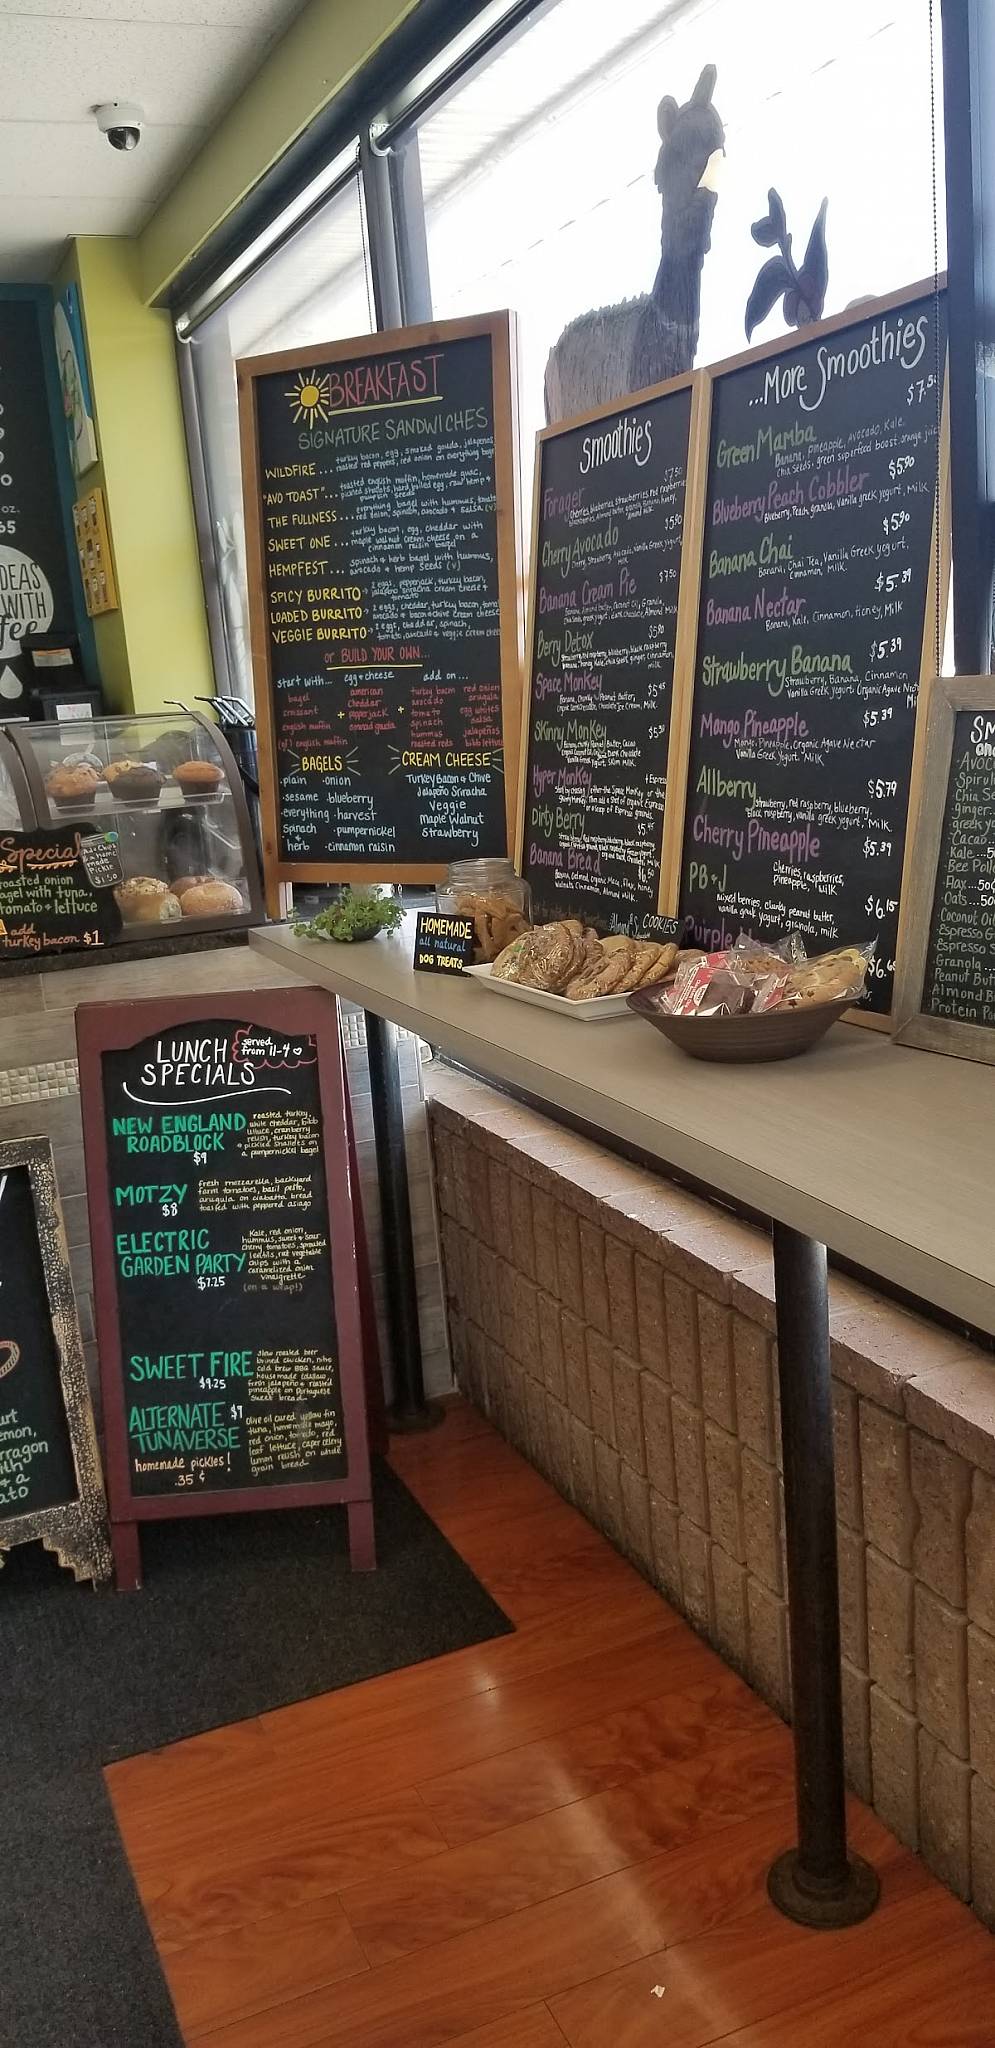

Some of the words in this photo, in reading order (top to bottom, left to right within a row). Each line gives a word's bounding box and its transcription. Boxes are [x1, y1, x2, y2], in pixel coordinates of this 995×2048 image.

[799, 316, 929, 411] Smoothies
[329, 354, 445, 408] BREAKFAST
[298, 423, 380, 450] SIGNATURE
[385, 407, 488, 440] SANDWICHES
[579, 417, 652, 474] Smoothies
[717, 440, 756, 468] Green
[757, 421, 816, 457] Mamba
[543, 487, 585, 521] Forager
[712, 495, 765, 527] Blueberry
[768, 479, 803, 511] Peach
[809, 466, 870, 501] Cobbler
[268, 515, 288, 527] THE
[268, 537, 305, 552] SWEET
[309, 536, 331, 549] ONE
[542, 540, 570, 578] Cherry
[573, 520, 619, 555] Avocado
[709, 549, 757, 579] Banana
[758, 535, 793, 563] Chai
[271, 590, 302, 604] SPICY
[307, 586, 361, 601] BURRITO
[539, 586, 576, 615] Banana
[582, 580, 613, 604] Cream
[619, 567, 637, 596] Pie
[271, 610, 308, 624] LOADED
[313, 606, 362, 621] BURRITO
[706, 598, 751, 626] Banana
[755, 588, 806, 617] Nectar
[272, 629, 313, 645] VEGGIE
[316, 626, 367, 640] BURRITO
[324, 652, 333, 663] or
[341, 648, 367, 663] BUILD
[373, 647, 394, 661] YOUR
[537, 630, 560, 668] Berry
[564, 631, 593, 650] Detox
[423, 671, 441, 681] add
[702, 652, 787, 697] Strawberry
[791, 645, 853, 674] Banana
[277, 676, 302, 689] start
[536, 673, 562, 700] Space
[700, 713, 740, 749] Mango
[743, 709, 809, 745] Pineapple
[843, 739, 876, 749] Nectar
[302, 755, 343, 772] BAGELS
[402, 752, 441, 767] CREAM
[446, 752, 491, 767] CHEESE
[469, 772, 491, 783] Chive
[533, 765, 556, 798] Hyper
[697, 765, 756, 808] Allberry
[956, 788, 979, 801] Chia
[429, 800, 466, 815] Veggie
[449, 813, 483, 824] Walnut
[532, 808, 553, 838] Dirty
[555, 808, 585, 834] Berry
[287, 839, 310, 851] herb
[368, 842, 395, 852] raisin
[693, 815, 743, 861] Cherry
[748, 820, 820, 864] Pineapple
[1, 832, 81, 873] Special
[529, 844, 563, 866] Banana
[567, 848, 602, 874] Bread
[948, 859, 969, 873] Bee
[45, 876, 73, 885] onion
[689, 862, 707, 892] PB
[719, 864, 726, 891] J
[26, 885, 51, 898] with
[0, 899, 42, 914] tomato
[55, 899, 98, 914] lettuce
[940, 908, 977, 926] Coconut
[11, 924, 36, 936] add
[420, 917, 472, 939] HOMEMADE
[939, 924, 983, 940] Espresso
[43, 933, 79, 945] bacon
[84, 930, 104, 945] $1
[419, 936, 430, 946] all
[435, 938, 466, 951] natural
[937, 939, 986, 954] Espresso
[420, 954, 434, 964] DOG
[437, 955, 463, 969] TREATS
[936, 954, 981, 971] Granola
[935, 968, 970, 982] Peanut
[932, 984, 982, 1001] Almond
[931, 998, 976, 1017] Protein
[241, 1038, 273, 1046] served
[241, 1046, 266, 1056] from
[157, 1039, 228, 1064] LUNCH
[140, 1062, 256, 1086] SPECIALS
[113, 1117, 153, 1135] NEW
[161, 1113, 246, 1134] ENGLAND
[127, 1133, 224, 1153] ROADBLOCK
[193, 1151, 207, 1165] $9
[116, 1183, 187, 1206] MOTZY
[162, 1203, 177, 1217] $8
[117, 1229, 209, 1255] ELECTRIC
[120, 1253, 190, 1278] GARDEN
[196, 1253, 245, 1274] PARTY
[197, 1277, 226, 1291] $7.25
[129, 1352, 204, 1382] SWEET
[210, 1351, 254, 1378] FIRE
[199, 1376, 226, 1390] $9.25
[129, 1401, 225, 1431] ALTERNATE
[131, 1426, 241, 1454] TUNAVERSE
[135, 1457, 185, 1472] homemade
